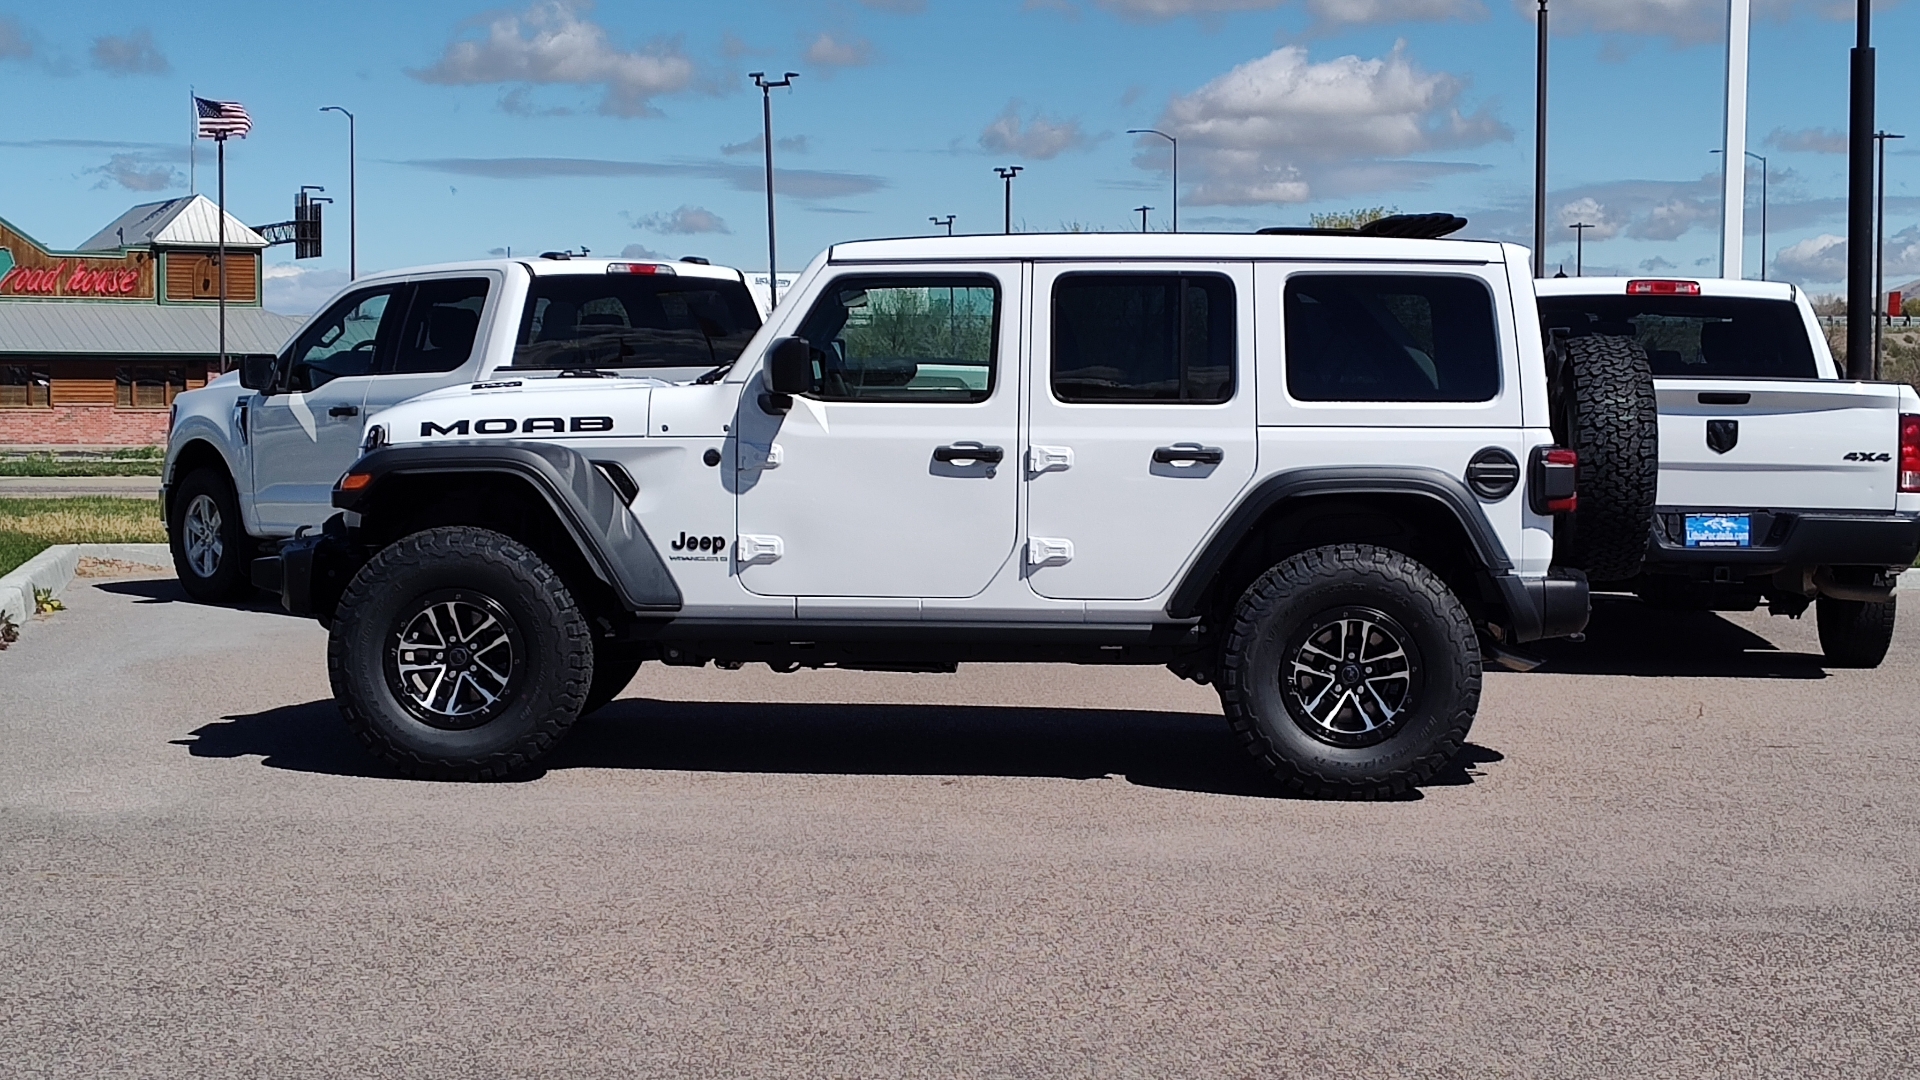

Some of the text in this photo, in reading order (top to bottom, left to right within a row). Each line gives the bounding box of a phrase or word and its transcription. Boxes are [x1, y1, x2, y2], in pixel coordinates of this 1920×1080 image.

[0, 258, 139, 293] road house
[420, 416, 614, 437] MOAB
[671, 531, 726, 555] Jeep
